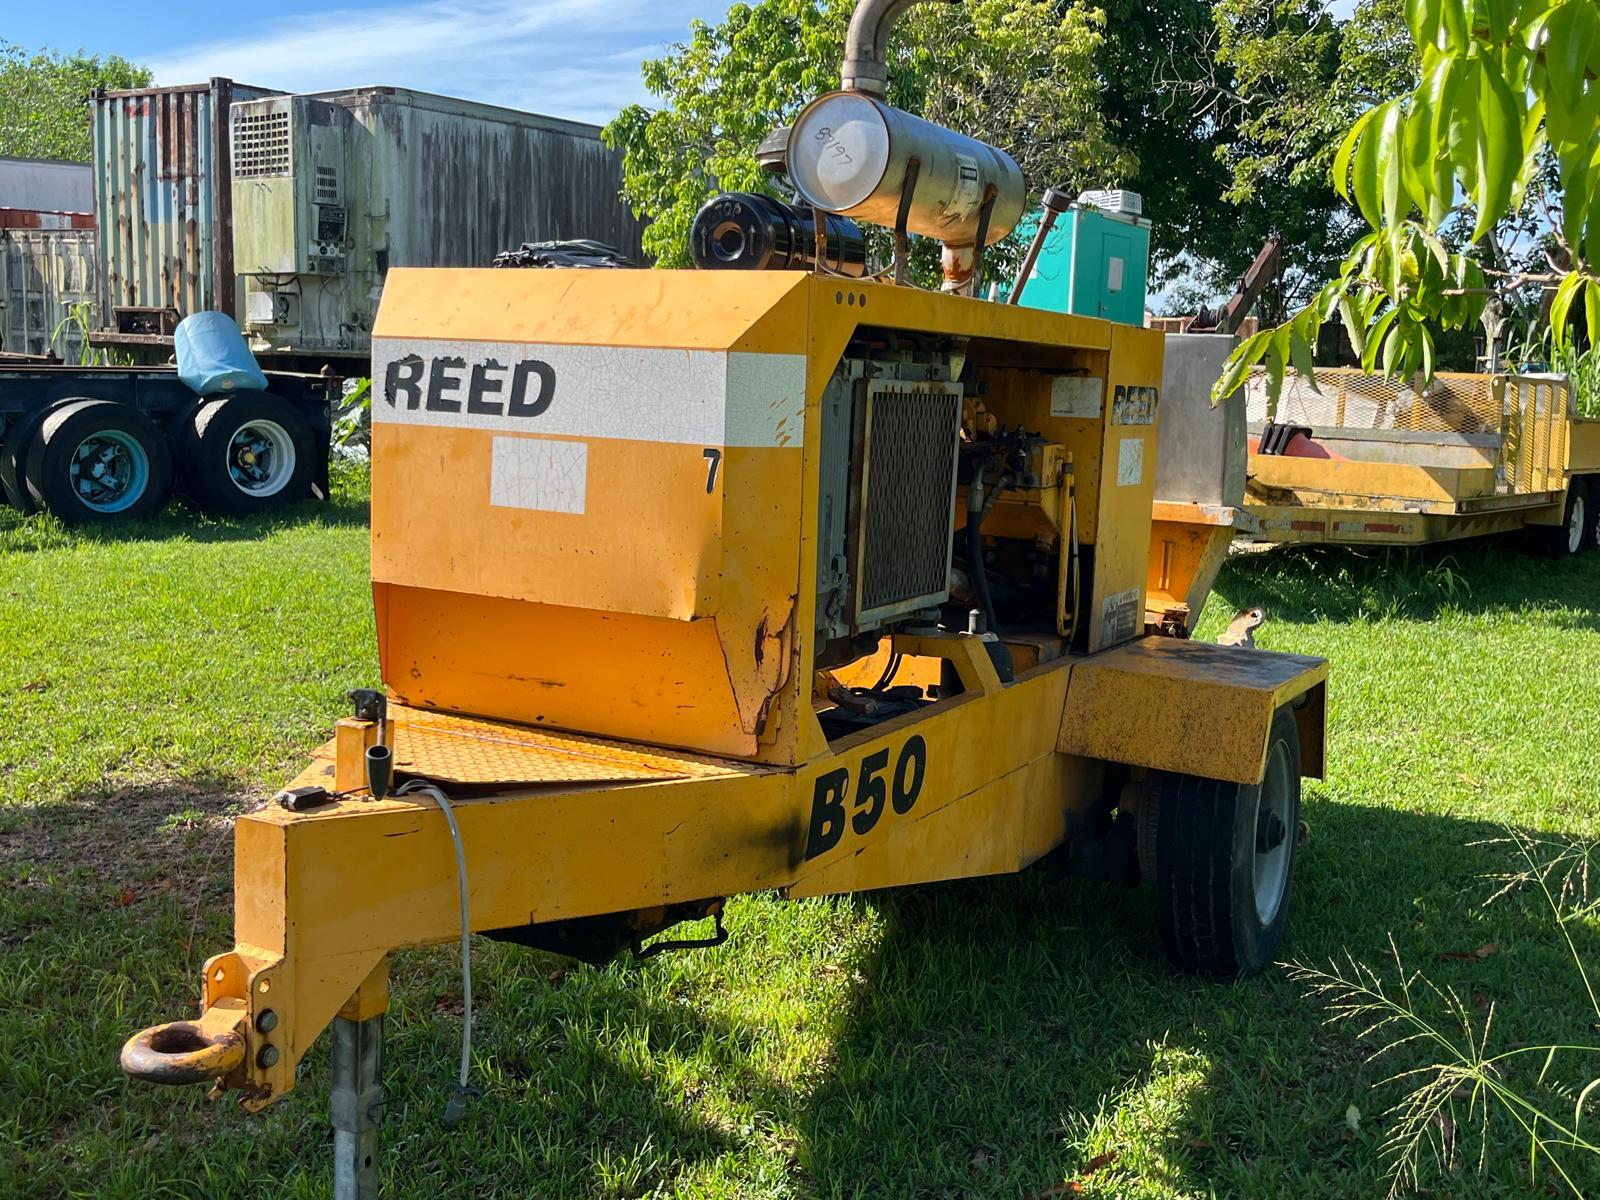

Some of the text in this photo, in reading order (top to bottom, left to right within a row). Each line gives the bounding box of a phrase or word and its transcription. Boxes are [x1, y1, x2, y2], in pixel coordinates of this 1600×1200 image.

[384, 353, 556, 418] REED
[1111, 384, 1159, 426] REED
[703, 448, 721, 494] 7
[805, 735, 926, 862] B50
